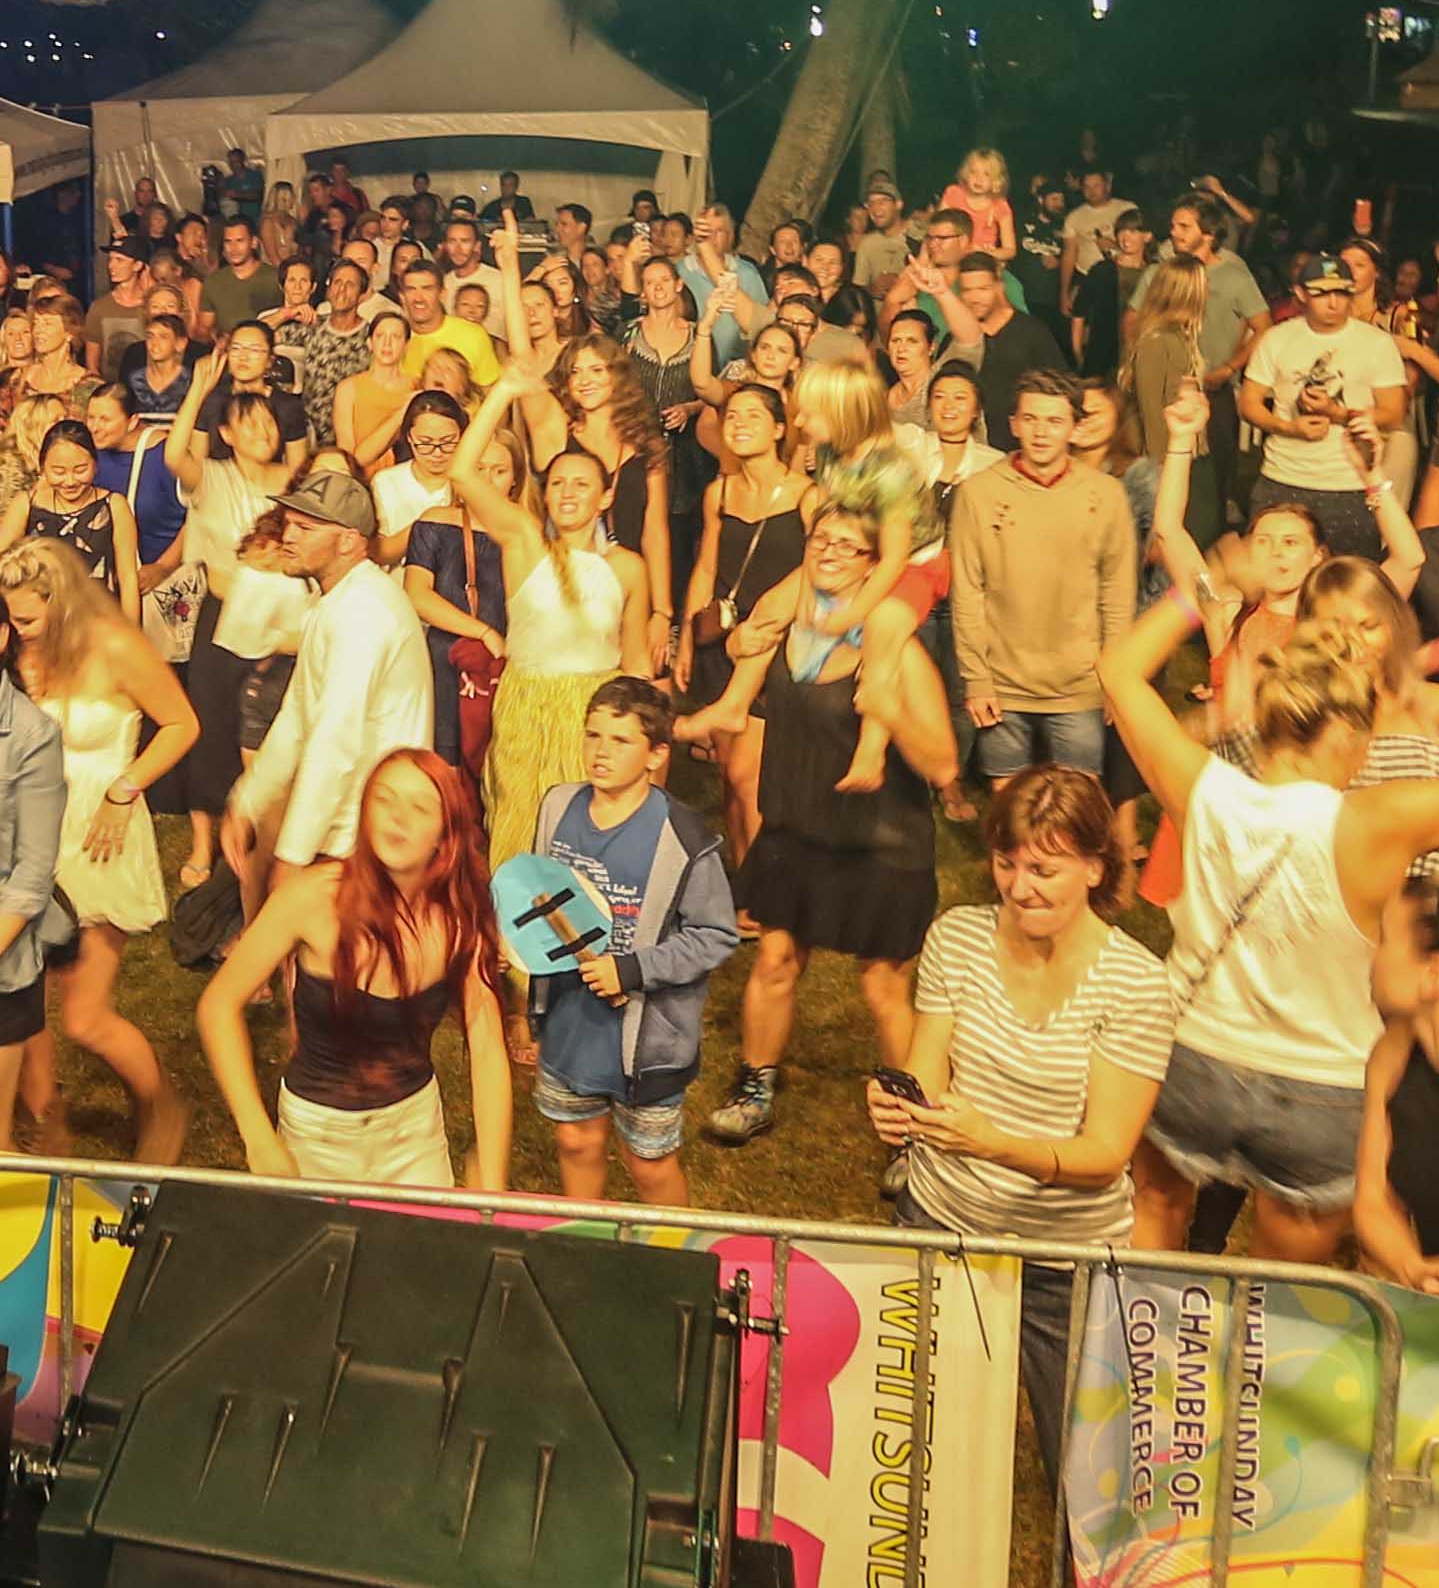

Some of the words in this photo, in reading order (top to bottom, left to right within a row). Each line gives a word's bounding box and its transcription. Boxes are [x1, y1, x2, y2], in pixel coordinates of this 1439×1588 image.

[1127, 1296, 1160, 1516] COMMERCE
[1169, 1284, 1212, 1465] CHAMBER
[1168, 1468, 1205, 1520] OF
